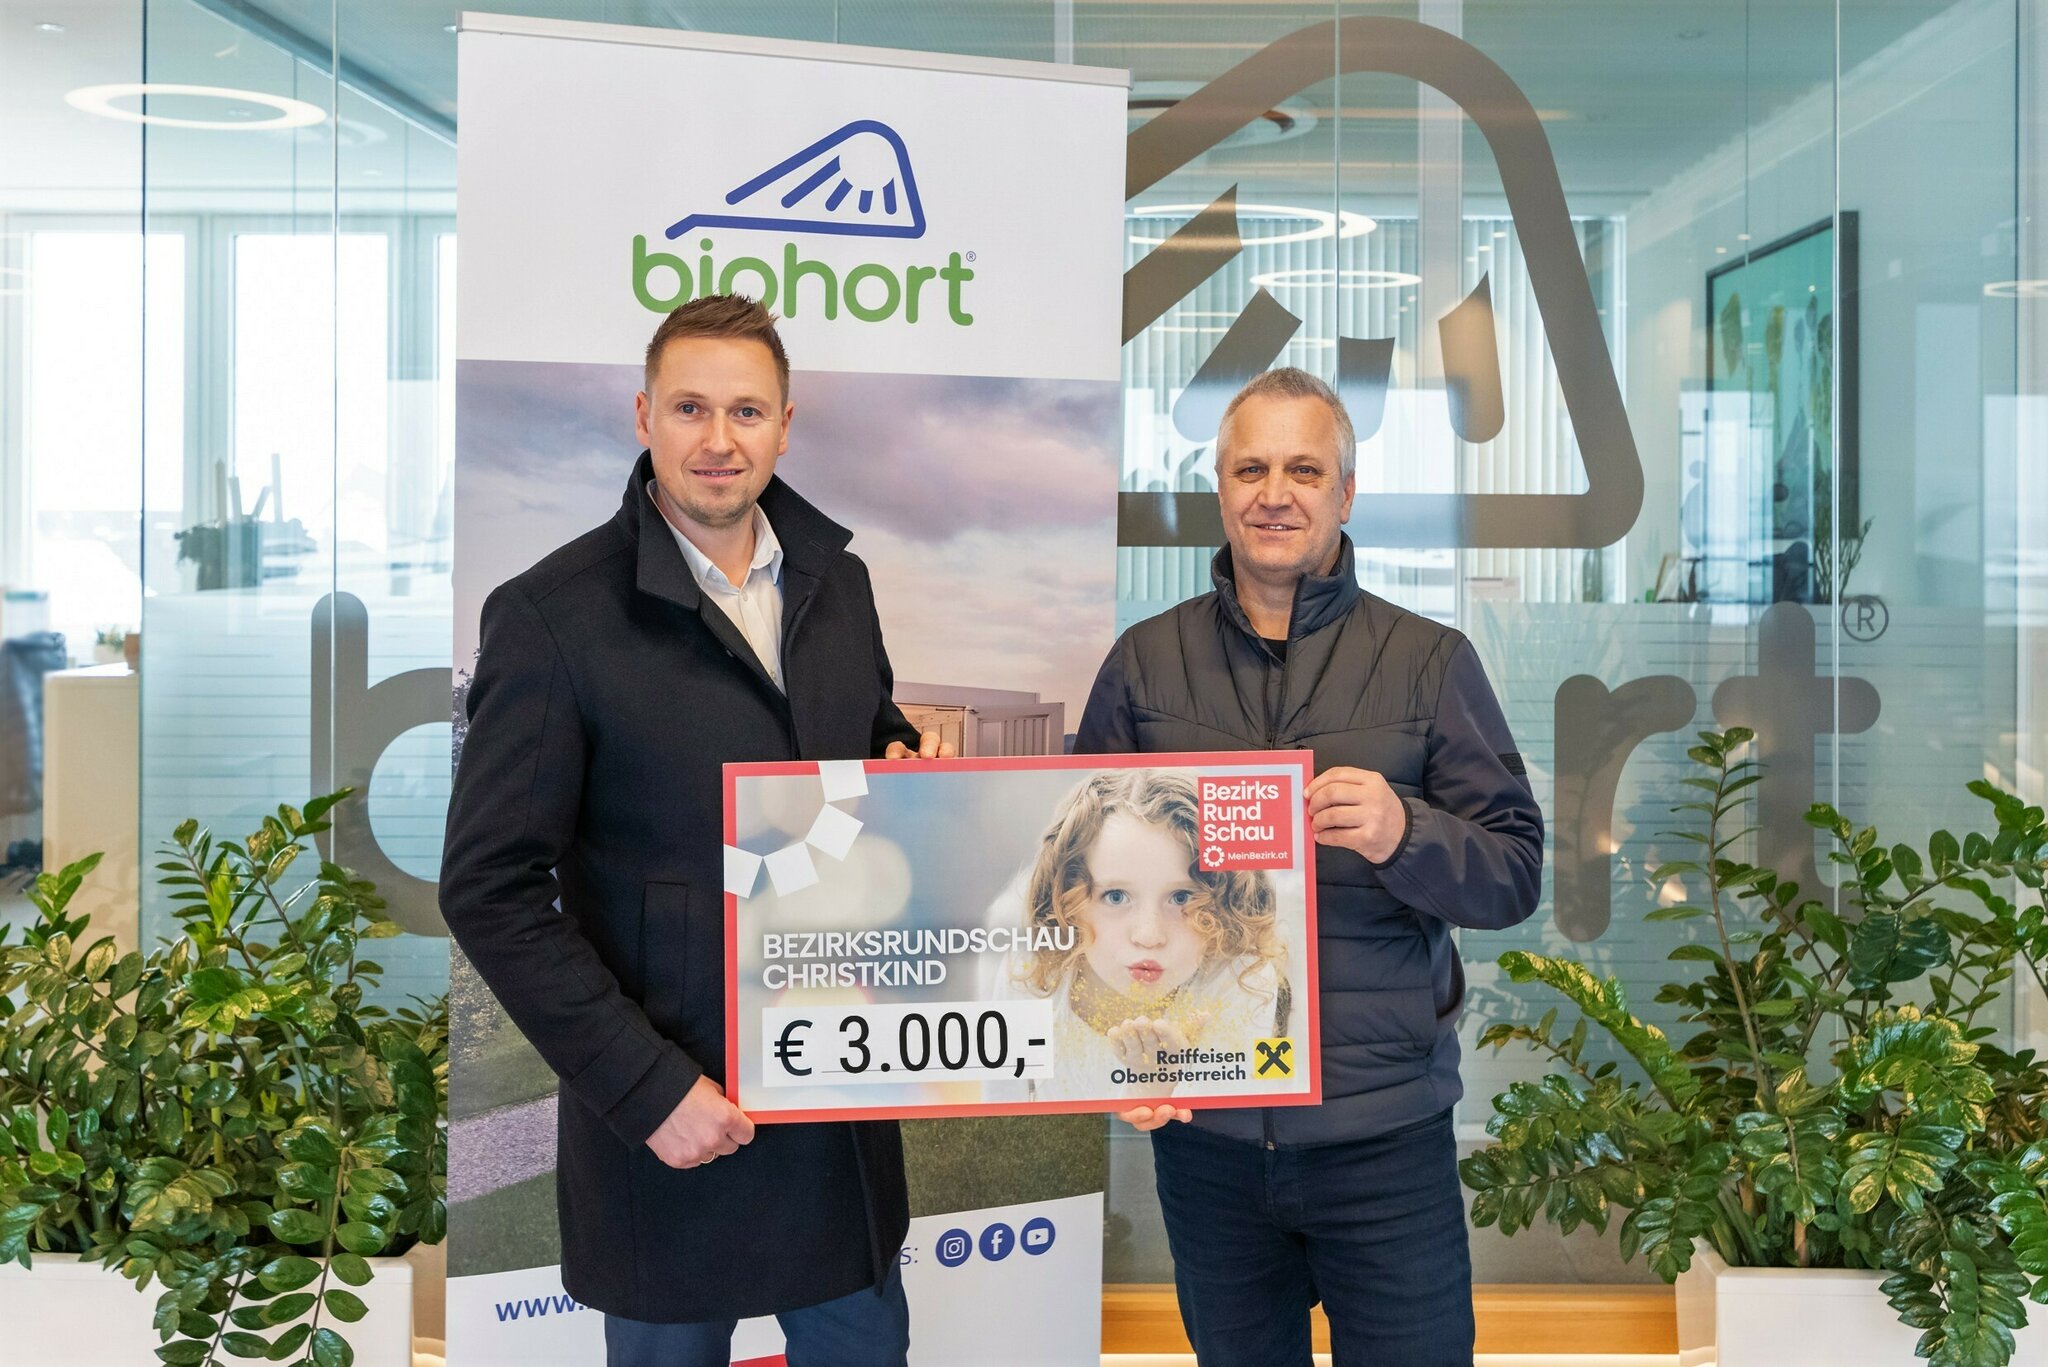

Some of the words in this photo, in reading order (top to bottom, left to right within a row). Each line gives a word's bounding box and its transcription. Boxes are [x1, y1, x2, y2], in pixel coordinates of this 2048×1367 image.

[632, 234, 974, 326] biohort
[1203, 780, 1279, 801] Bezirks
[1203, 801, 1261, 822] Rund
[1203, 822, 1274, 842] Schau
[1227, 850, 1288, 861] MeinBezirk.at
[762, 925, 1075, 960] BEZIRKSRUNDSCHAU
[762, 959, 947, 990] CHRISTKIND
[838, 1010, 1046, 1079] 3.000,-
[1156, 1048, 1246, 1065] Raiffeisen
[1110, 1064, 1246, 1084] Oberösterreich
